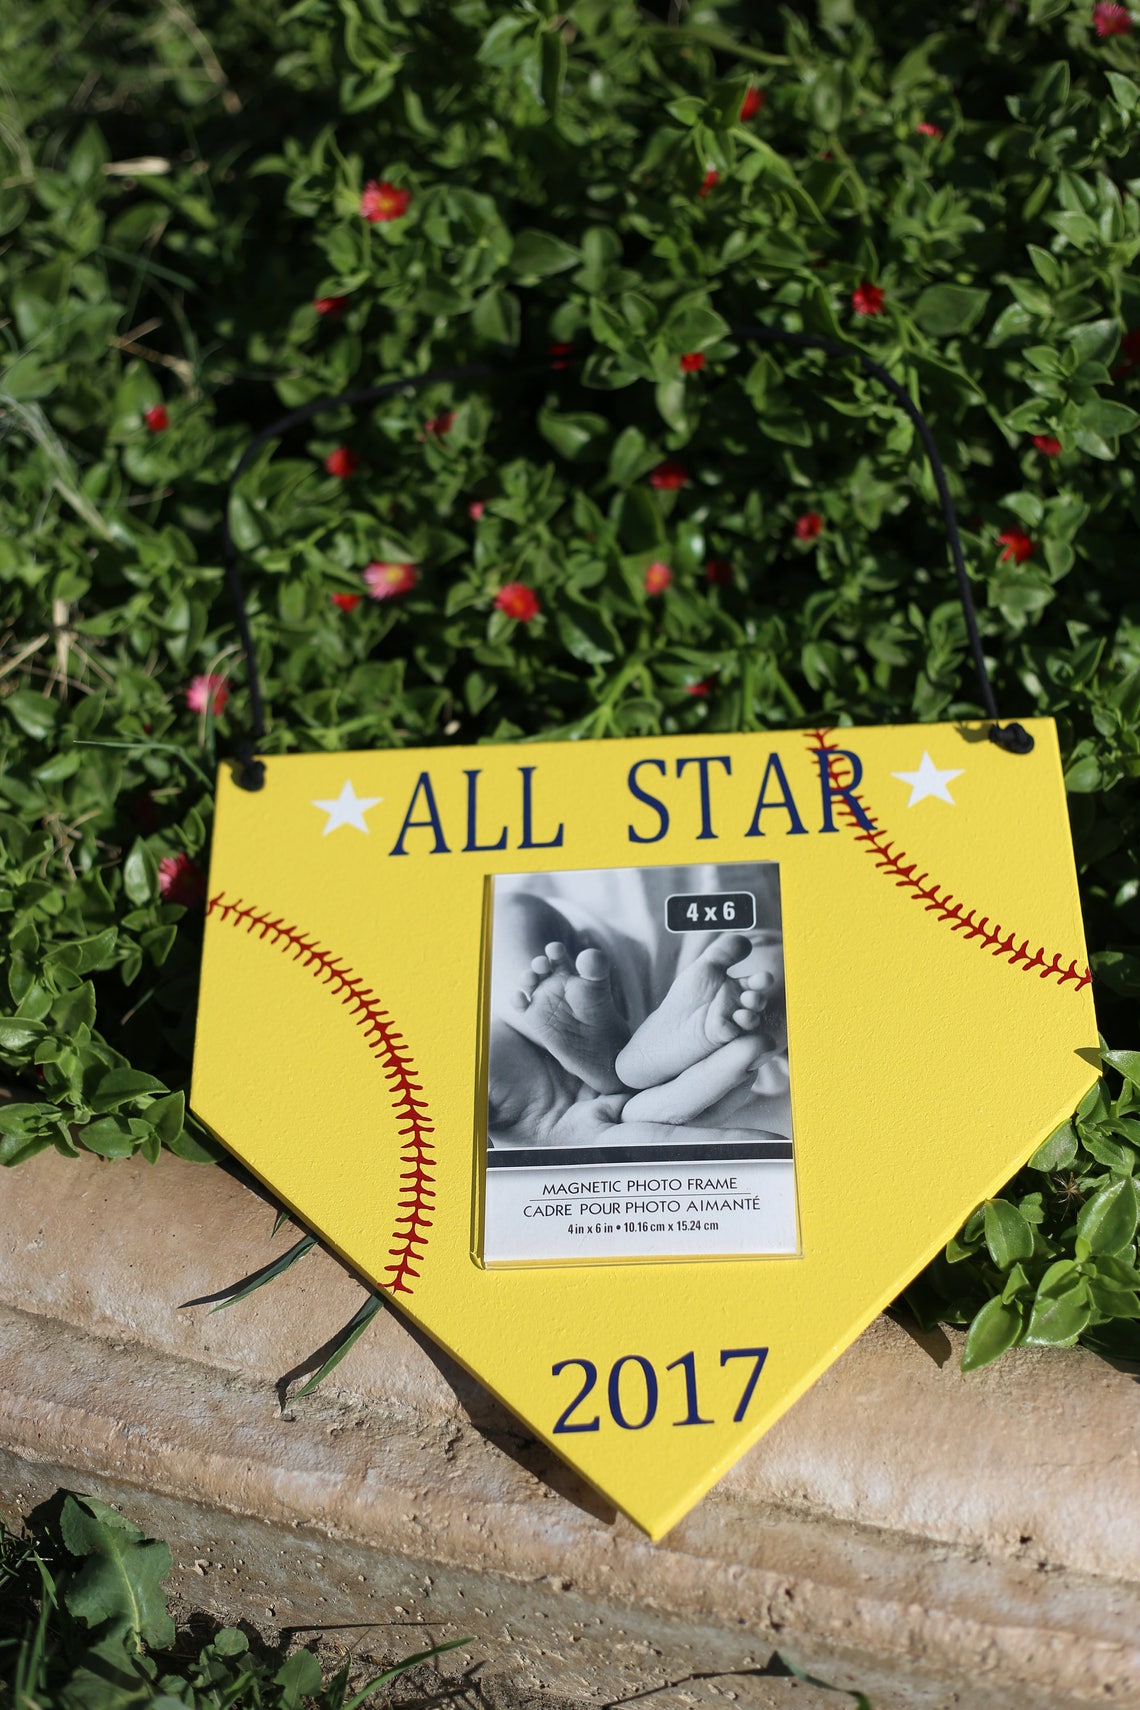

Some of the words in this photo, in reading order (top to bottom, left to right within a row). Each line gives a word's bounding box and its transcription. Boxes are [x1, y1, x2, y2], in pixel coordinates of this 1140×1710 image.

[389, 766, 565, 857] ALL
[628, 749, 877, 843] STAR
[686, 902, 699, 922] 4
[704, 906, 718, 922] x
[722, 901, 736, 921] 6
[543, 1181, 621, 1195] MAGNETIC
[627, 1179, 682, 1192] PHOTO
[688, 1178, 737, 1190] FRAME
[523, 1204, 572, 1217] CADRE
[580, 1202, 620, 1215] POUR
[626, 1200, 680, 1213] PHOTO
[686, 1195, 761, 1213] AIMANTÉ
[586, 1226, 593, 1234] x
[595, 1223, 601, 1234] 6
[604, 1223, 613, 1233] in
[624, 1221, 648, 1232] 10.16
[667, 1224, 673, 1232] x
[677, 1220, 701, 1231] 15.24
[551, 1347, 769, 1434] 2017
